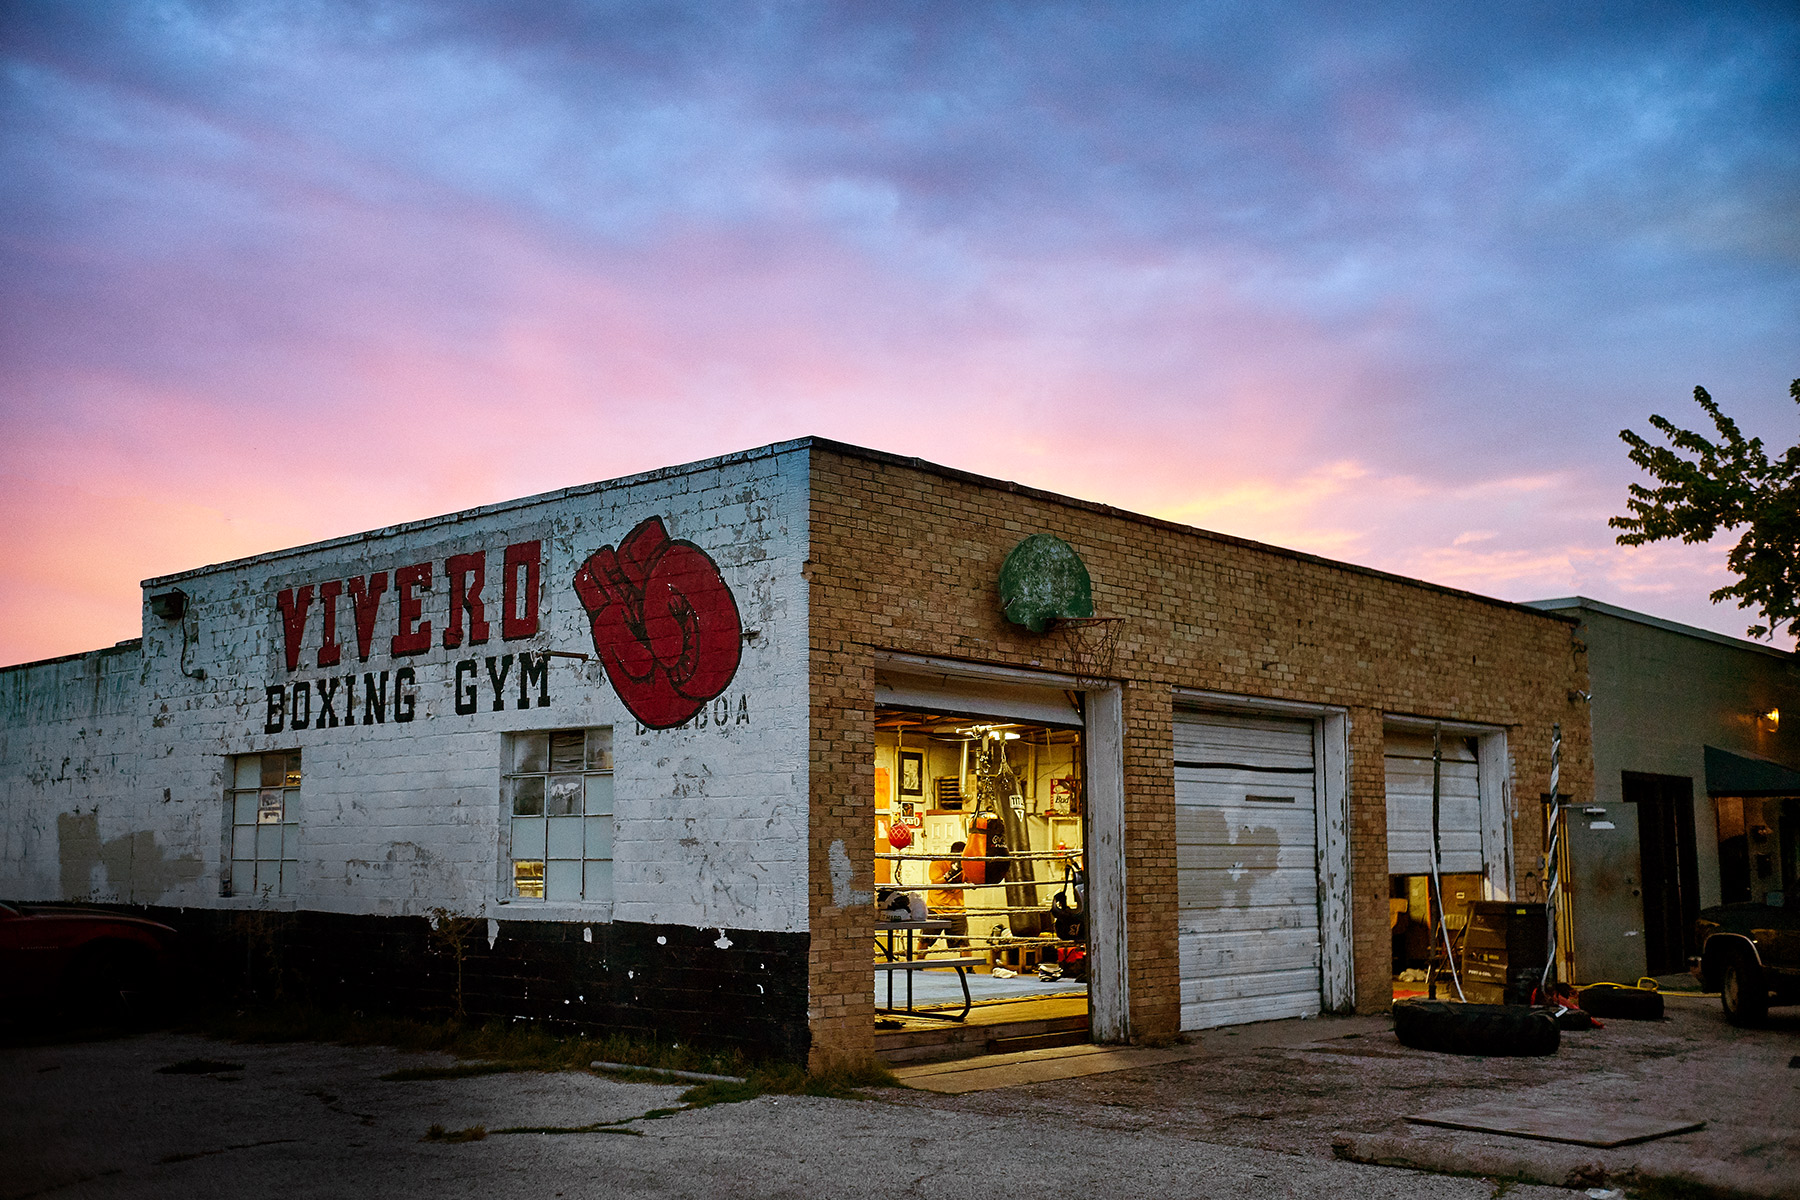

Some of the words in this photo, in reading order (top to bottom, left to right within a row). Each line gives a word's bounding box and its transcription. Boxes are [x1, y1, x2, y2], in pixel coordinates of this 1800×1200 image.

[277, 540, 541, 672] VIVERO
[264, 667, 416, 734] BOXING
[455, 652, 551, 716] GYM
